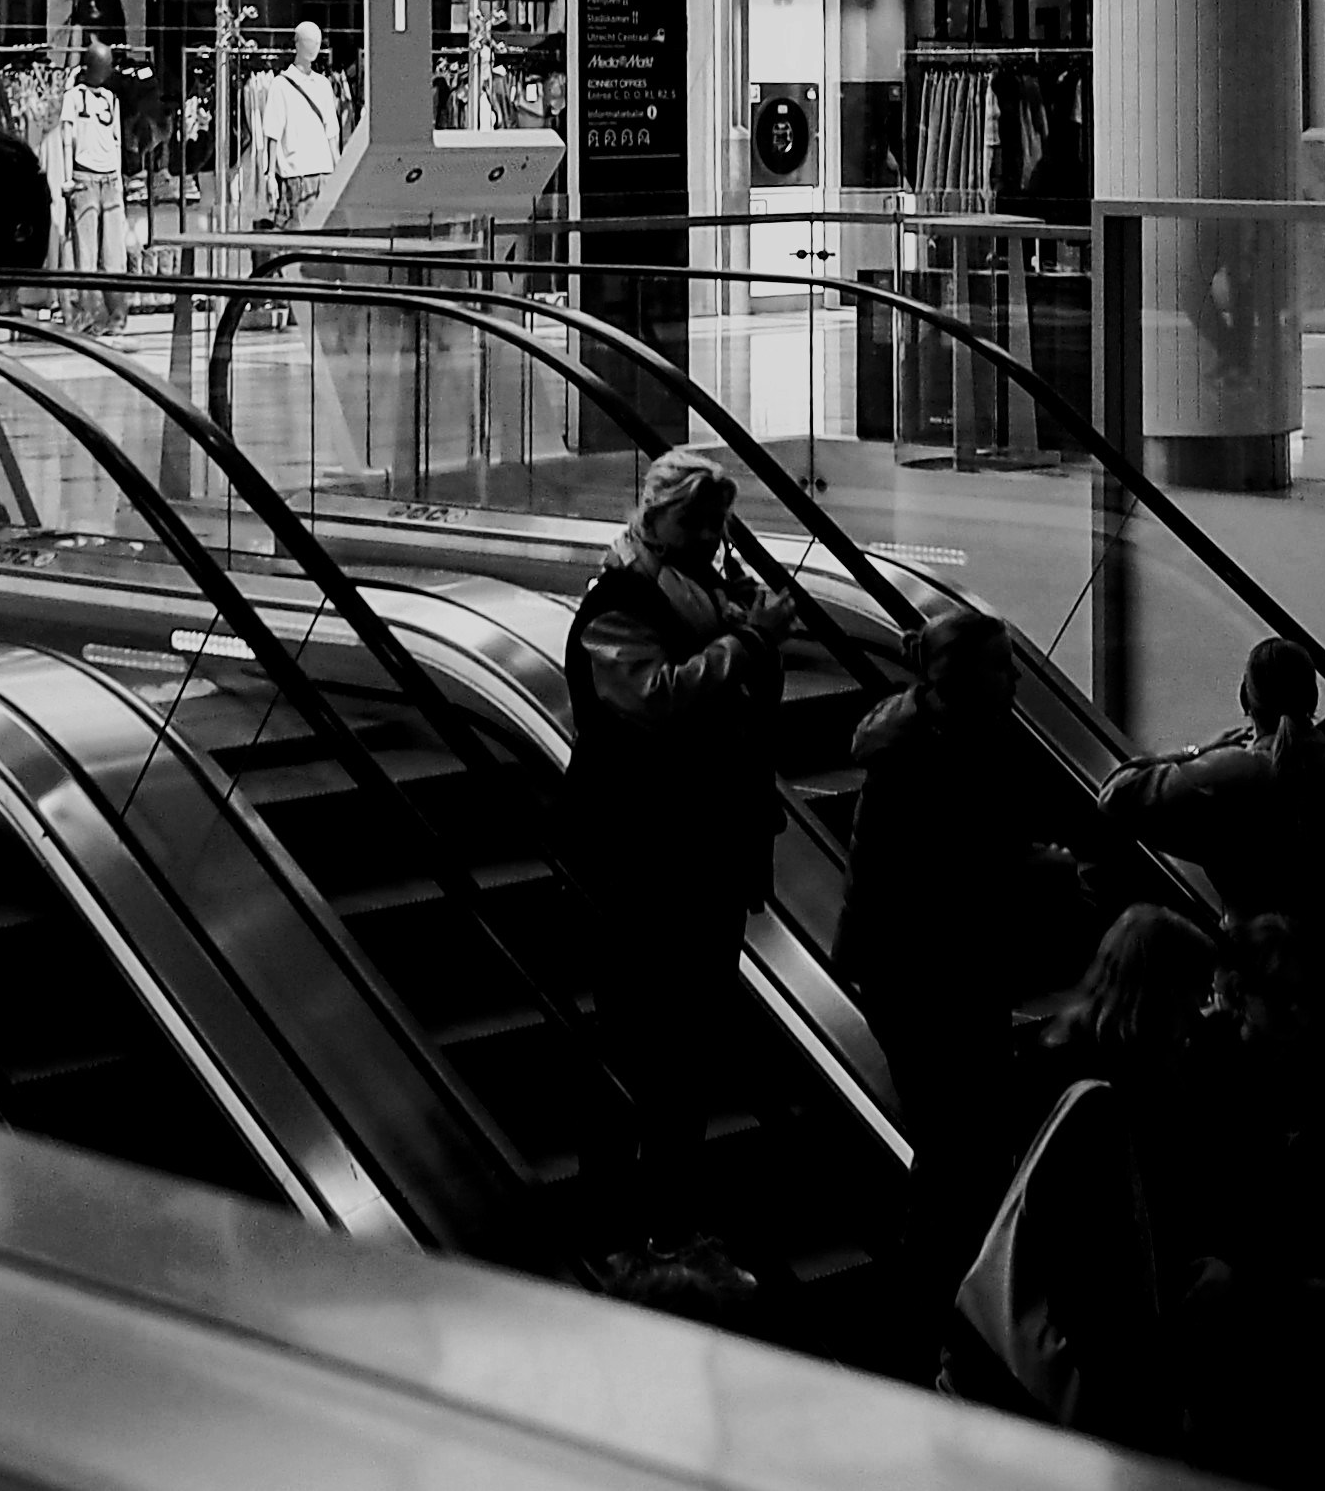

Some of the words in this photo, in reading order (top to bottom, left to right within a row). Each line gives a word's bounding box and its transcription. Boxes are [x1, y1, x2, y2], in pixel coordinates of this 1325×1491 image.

[587, 32, 616, 42] Utrecht
[618, 32, 650, 43] Centraal
[78, 88, 114, 126] 13
